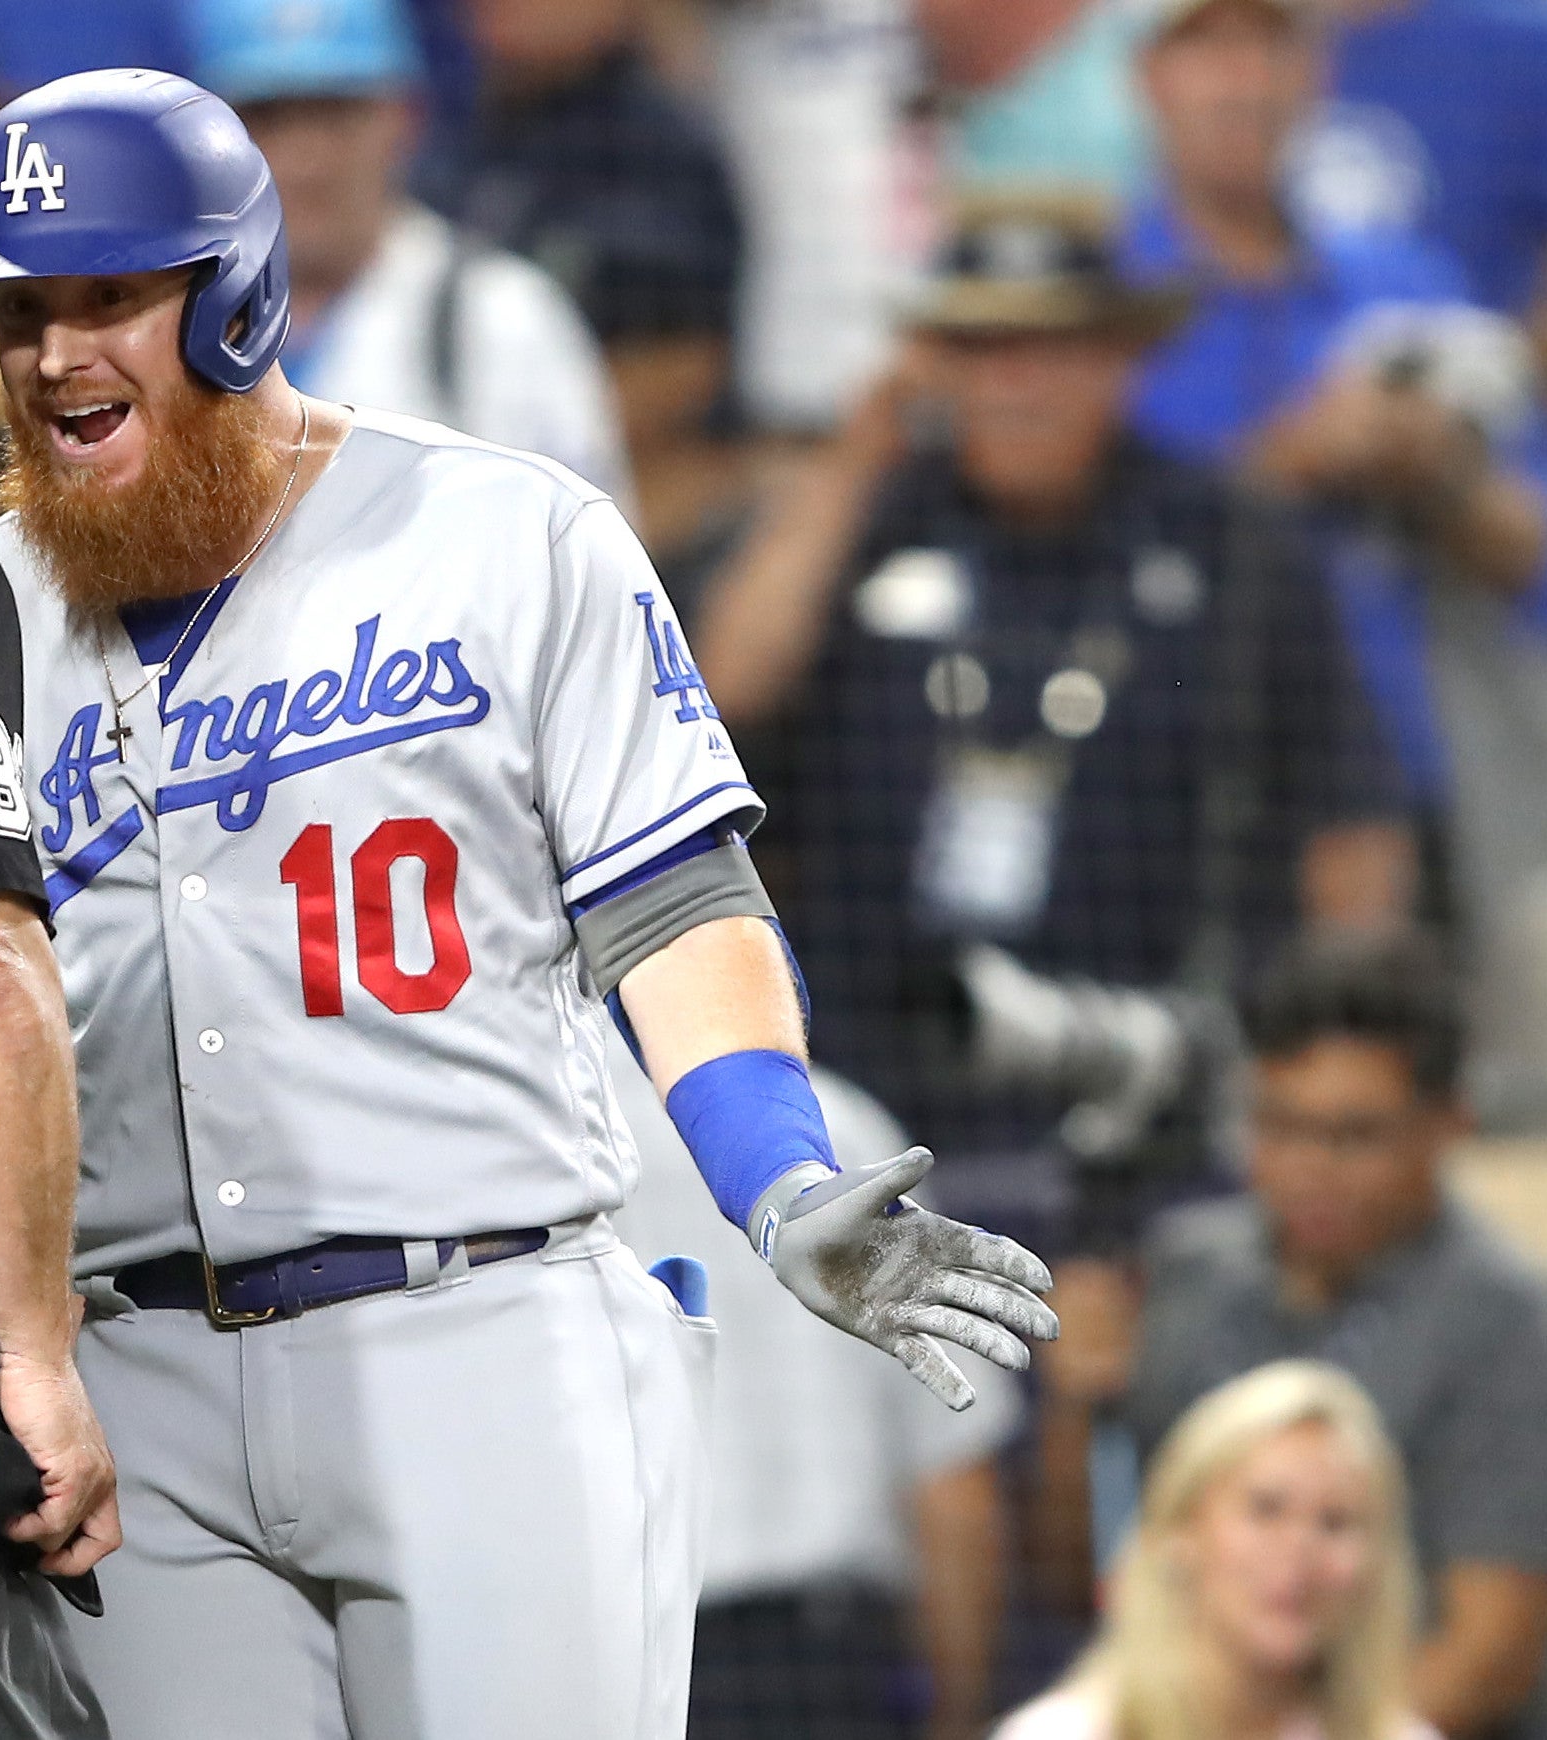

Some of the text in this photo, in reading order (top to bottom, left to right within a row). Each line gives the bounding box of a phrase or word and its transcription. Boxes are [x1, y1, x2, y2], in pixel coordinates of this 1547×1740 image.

[0, 122, 65, 214] LA
[40, 614, 491, 852] Angeles
[634, 590, 721, 723] LA
[279, 816, 472, 1017] 10
